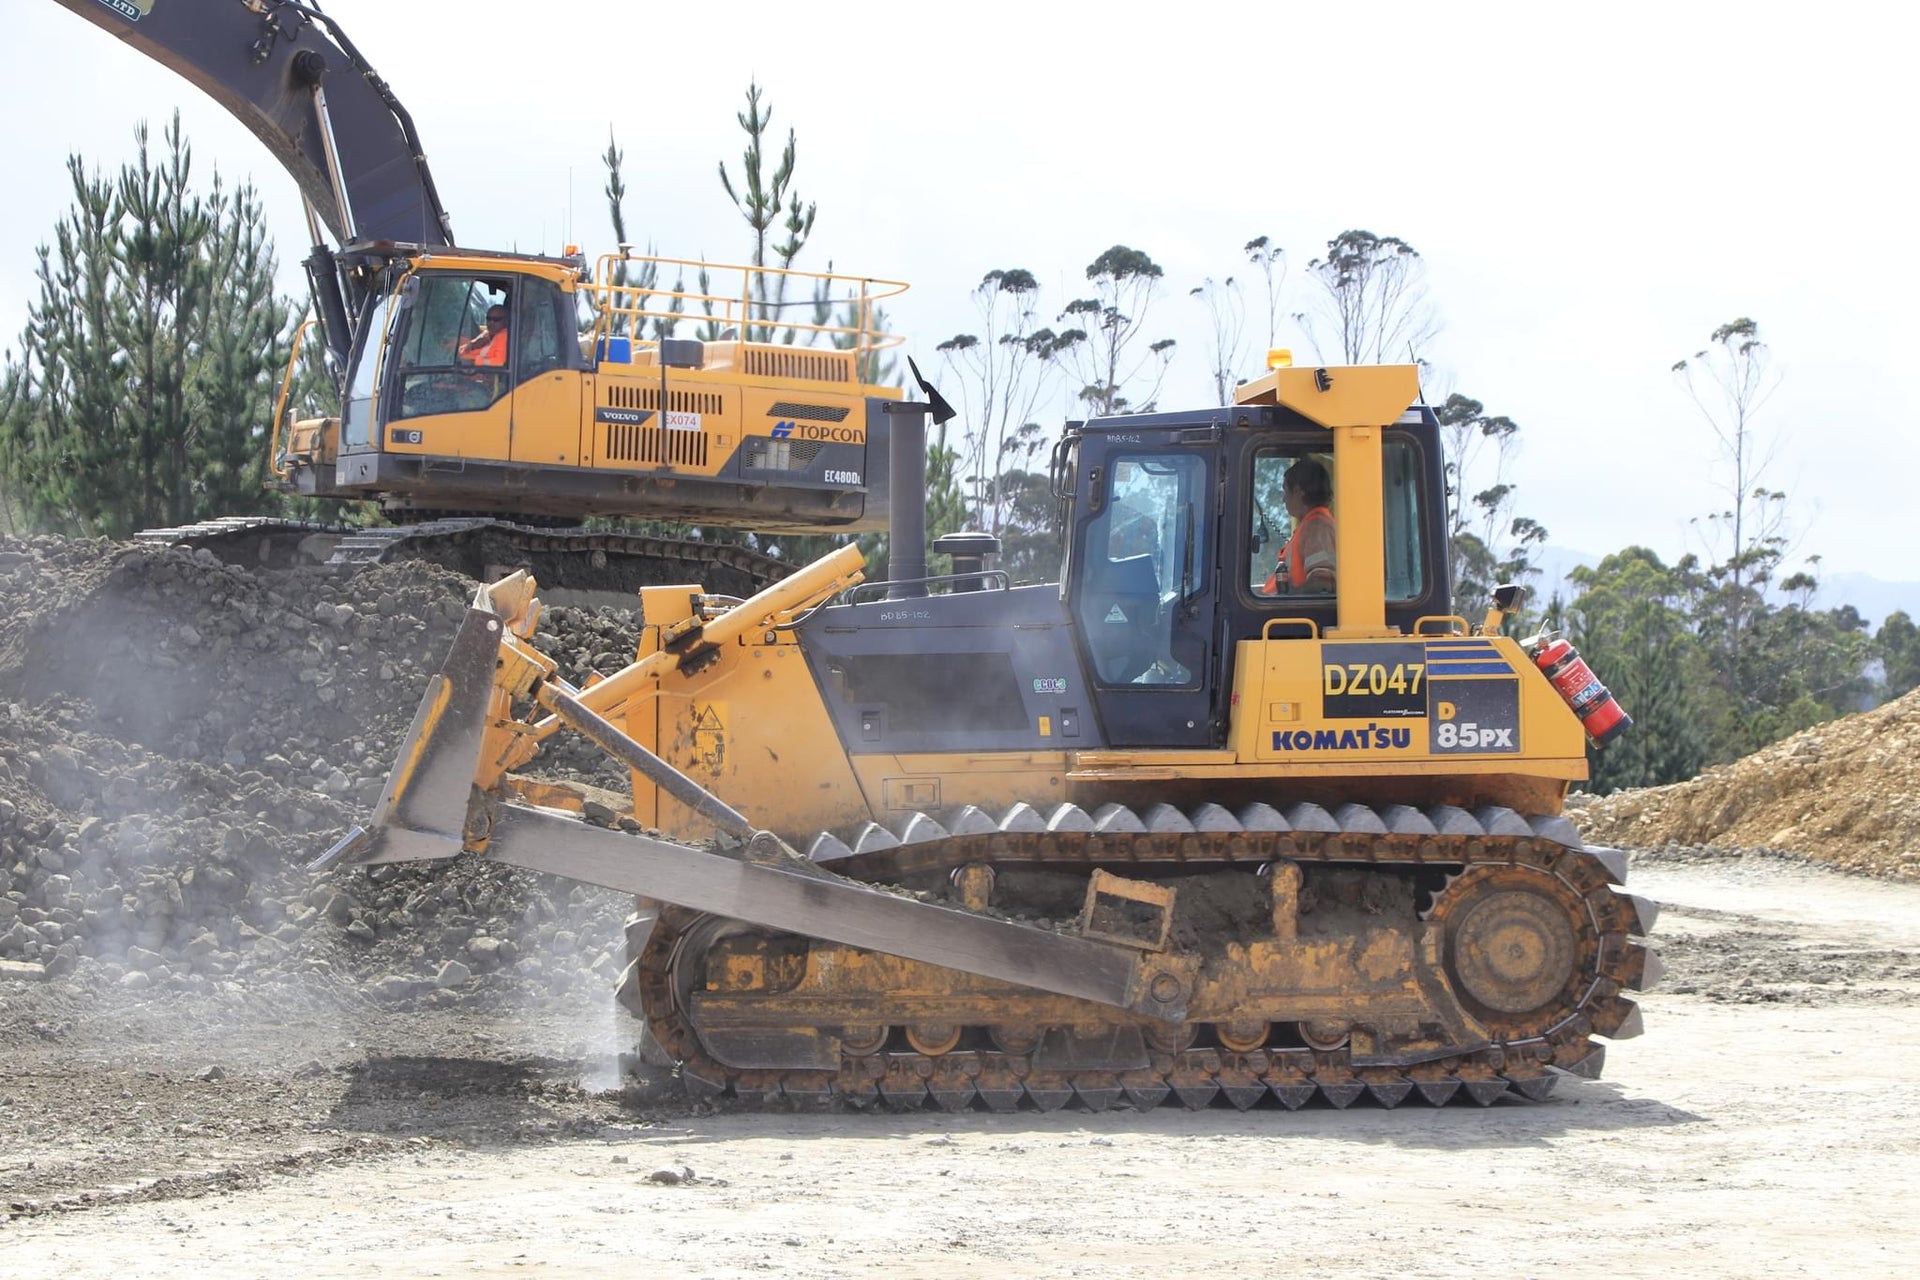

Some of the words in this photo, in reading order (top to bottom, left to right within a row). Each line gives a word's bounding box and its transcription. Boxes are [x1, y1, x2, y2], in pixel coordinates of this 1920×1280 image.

[112, 0, 136, 16] LTD
[603, 412, 639, 421] VOLVO
[797, 424, 865, 443] TOPCON
[1324, 663, 1425, 696] DZ047
[1438, 701, 1456, 720] D
[1272, 722, 1411, 751] KOMATSU
[1437, 722, 1513, 748] 85PX
